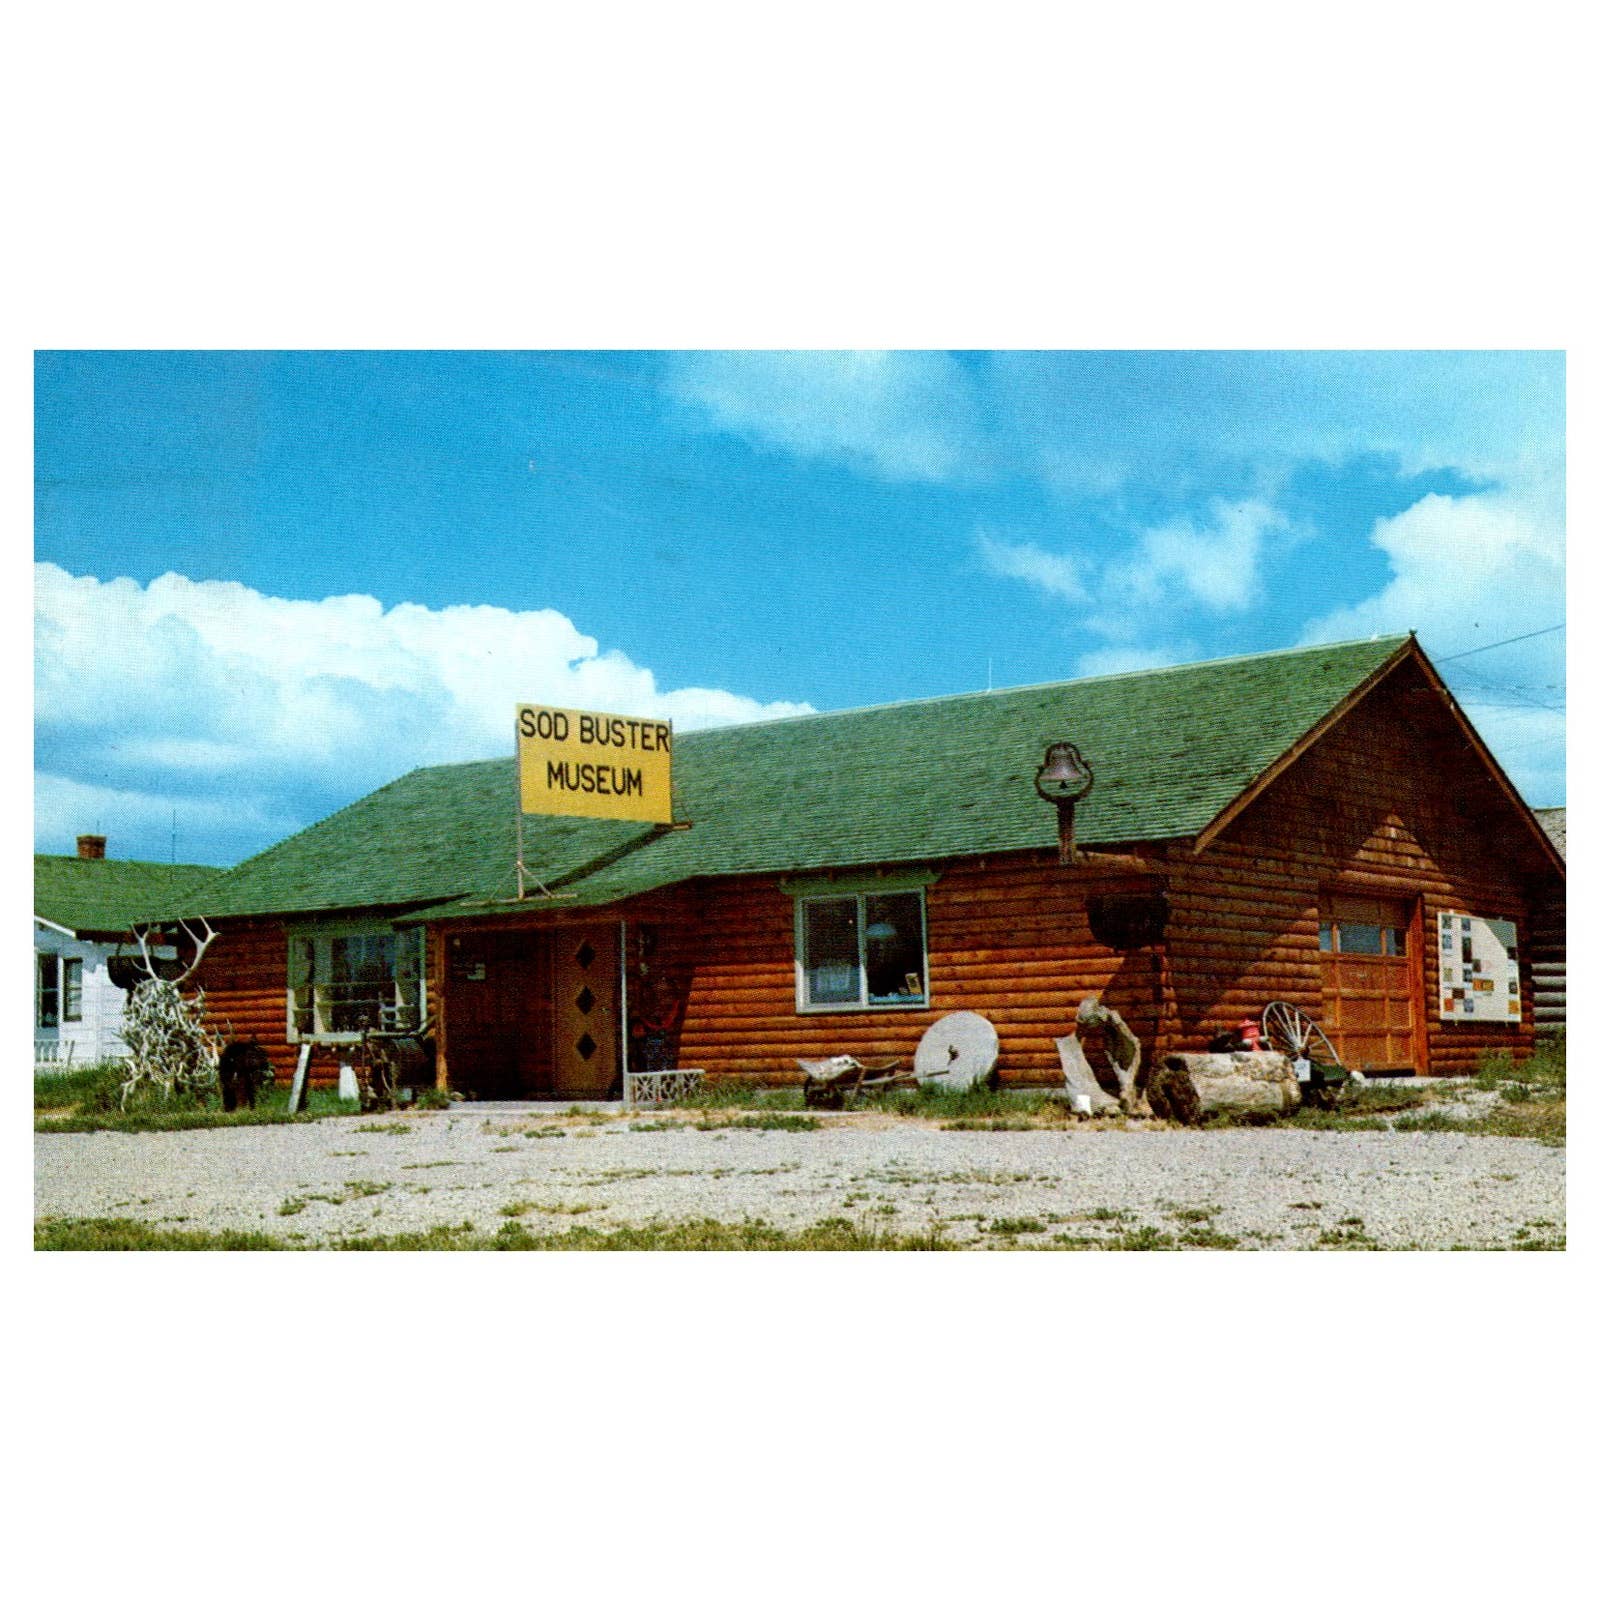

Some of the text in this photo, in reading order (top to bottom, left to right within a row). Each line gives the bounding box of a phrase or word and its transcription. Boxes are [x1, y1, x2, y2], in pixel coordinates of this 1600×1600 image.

[520, 708, 670, 752] SOD BUSTER
[547, 760, 643, 797] MUSEUM
